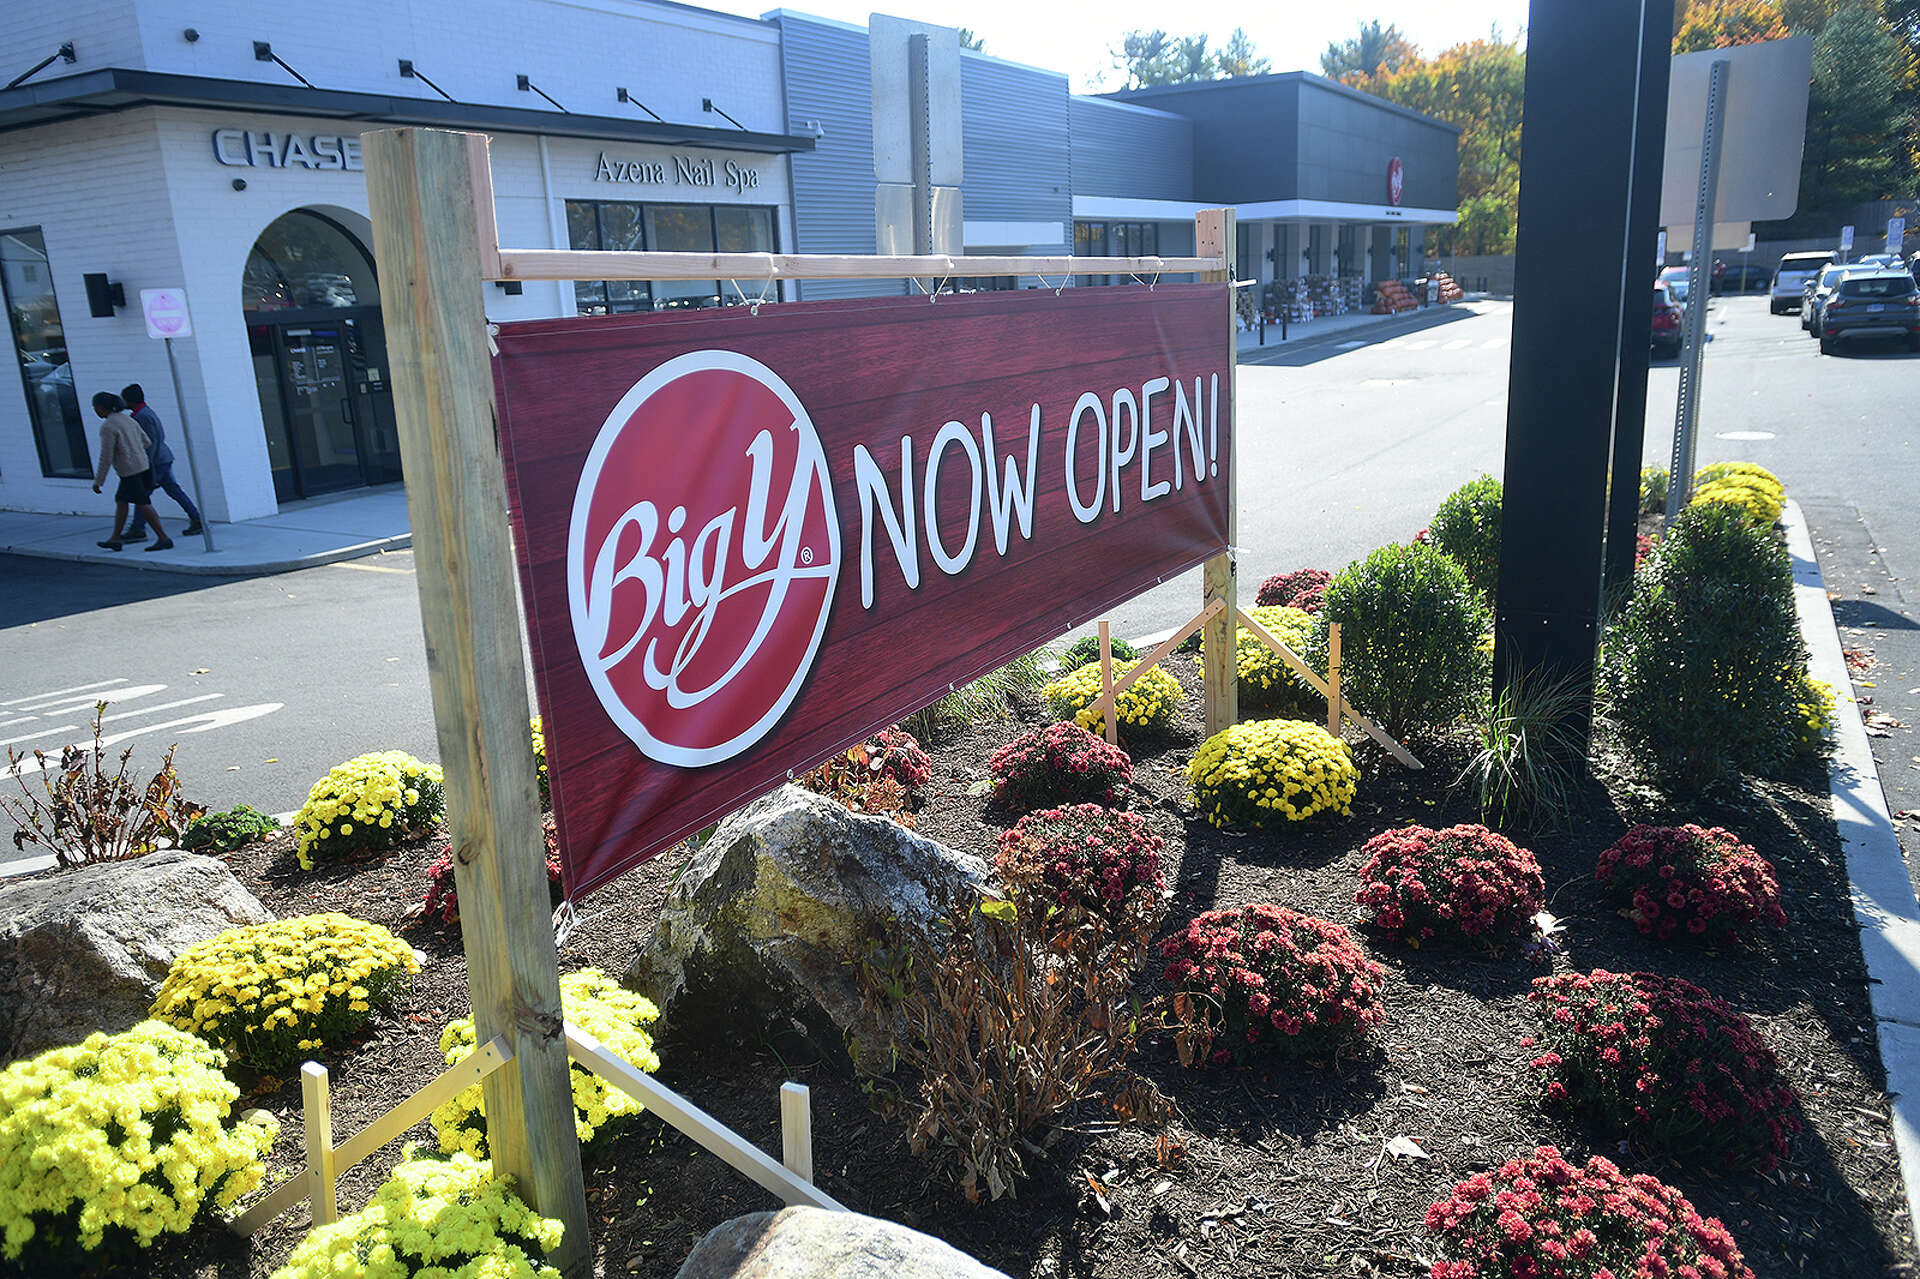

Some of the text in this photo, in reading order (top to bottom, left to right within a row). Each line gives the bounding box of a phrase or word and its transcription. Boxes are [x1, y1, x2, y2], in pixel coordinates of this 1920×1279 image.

[212, 128, 365, 171] CHASE
[594, 151, 761, 195] Azena Nail Spa
[853, 372, 1219, 610] NOW OPEN!
